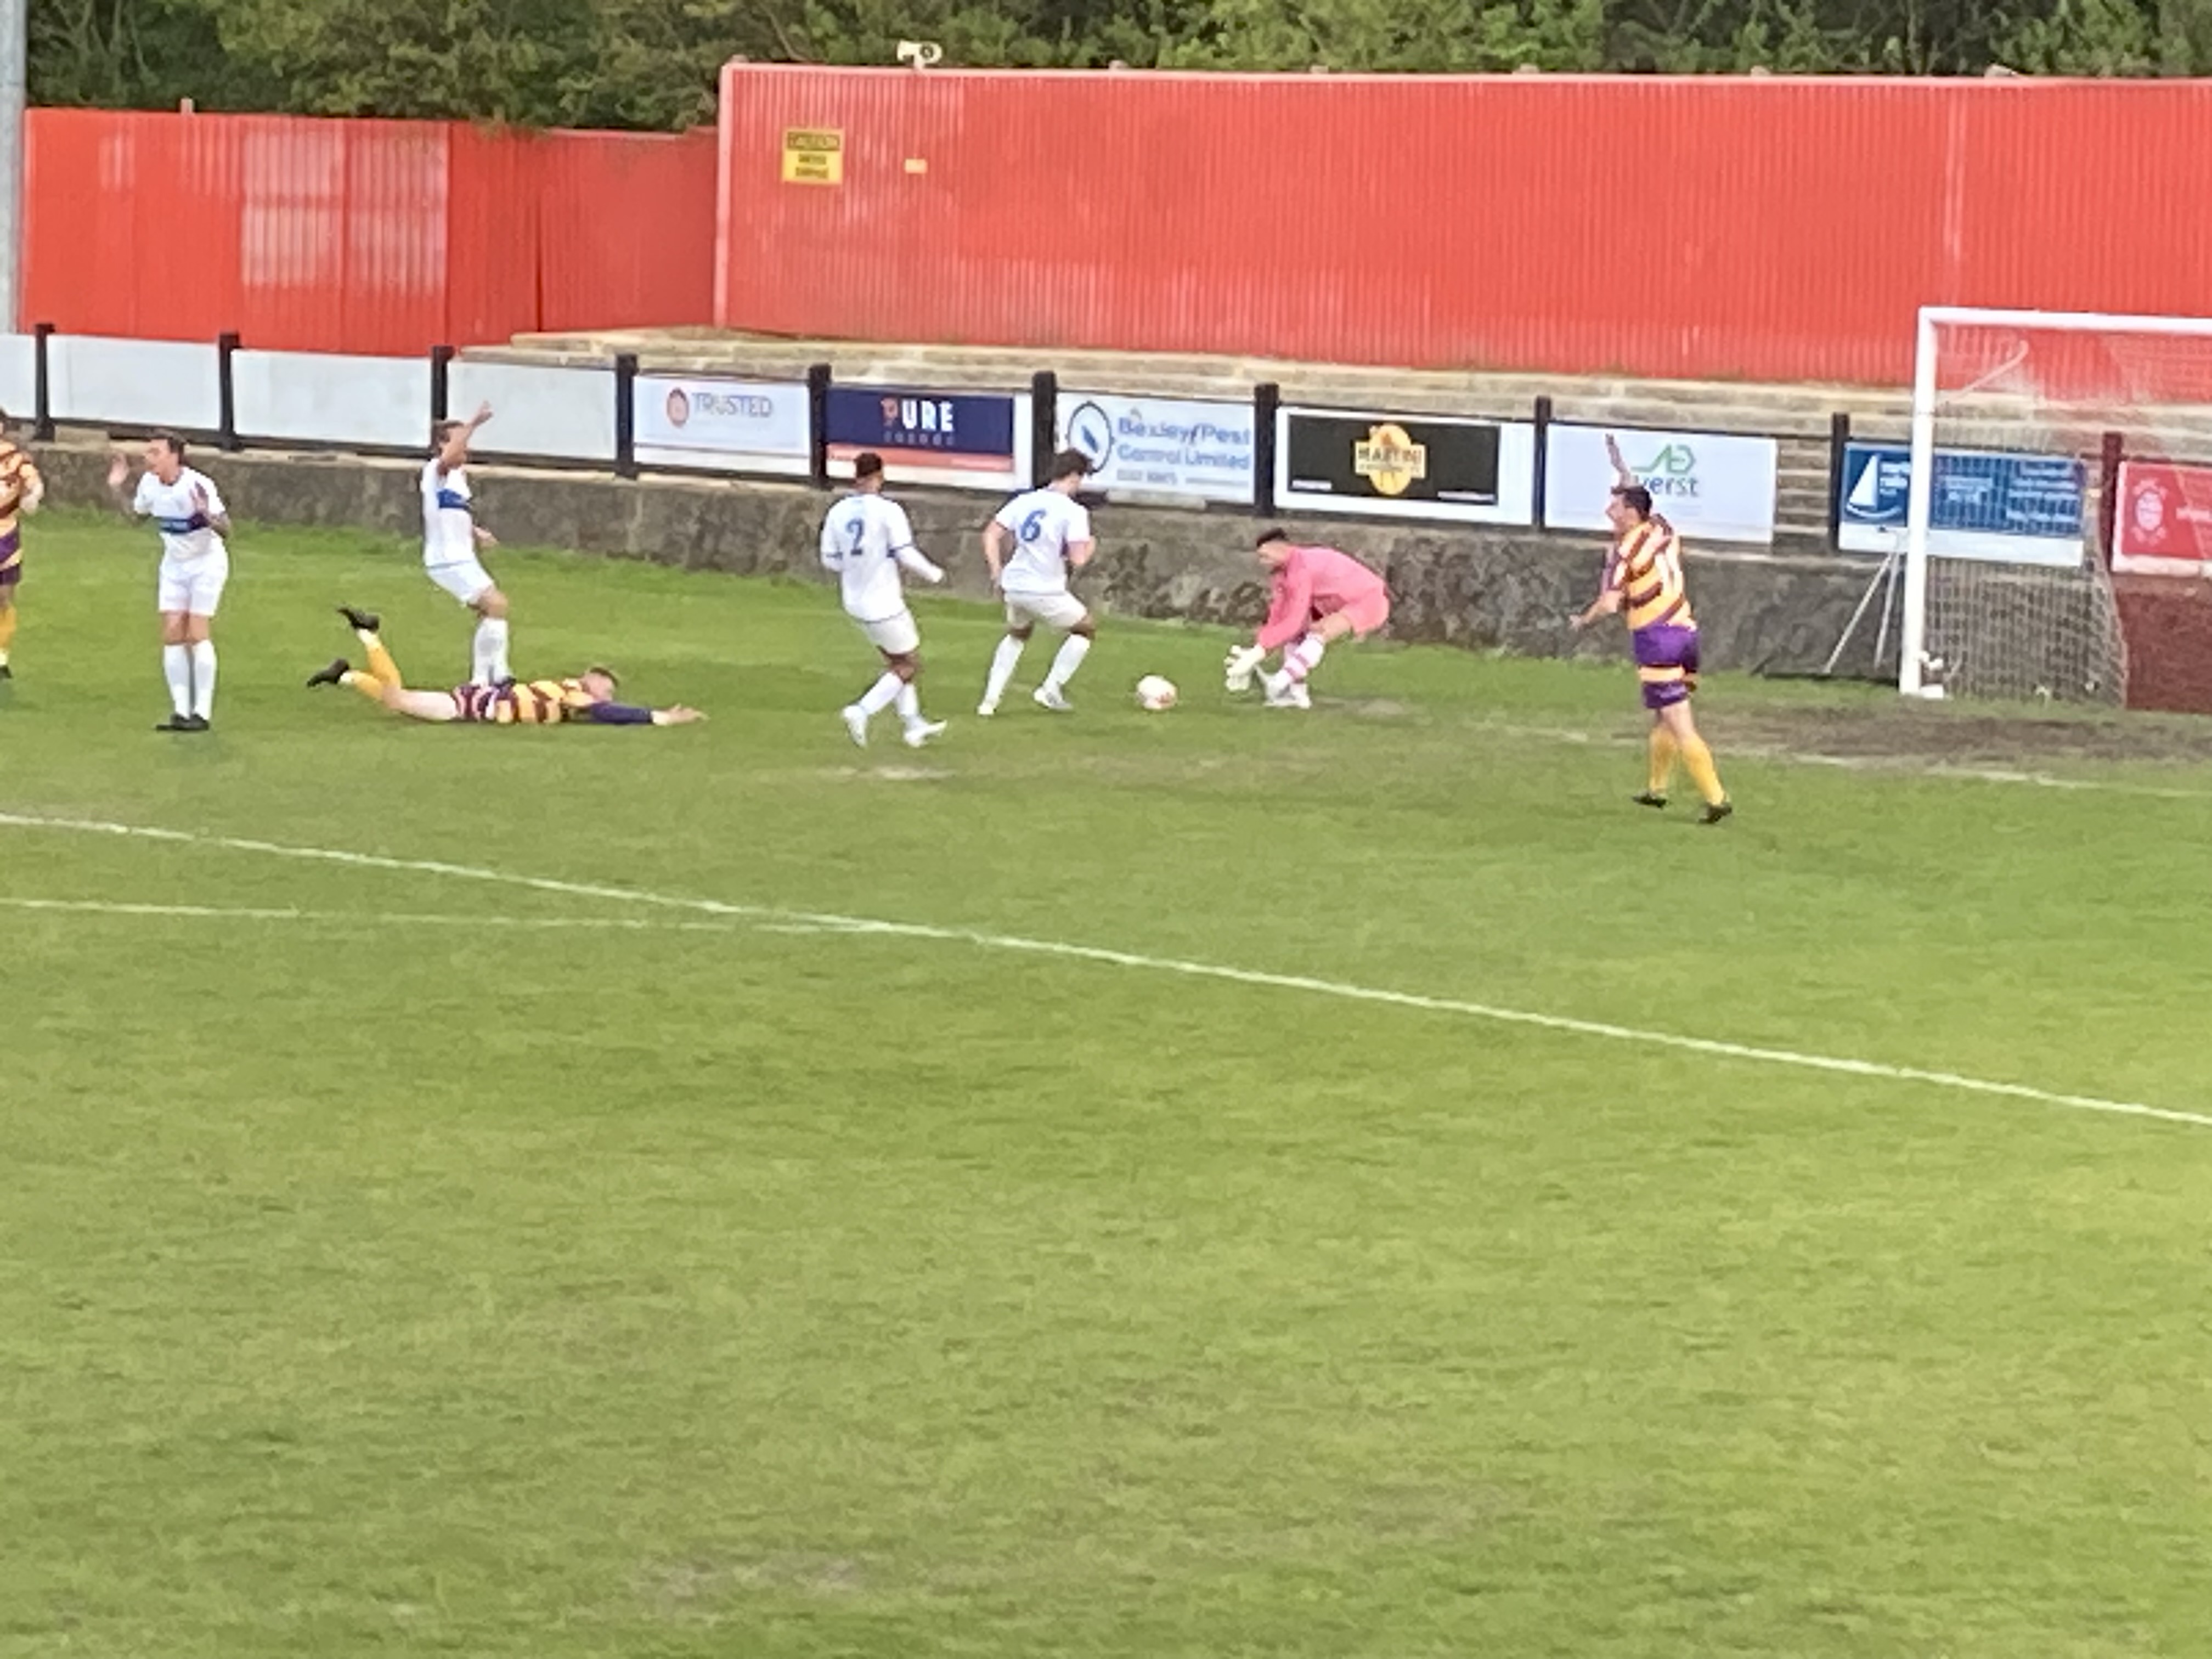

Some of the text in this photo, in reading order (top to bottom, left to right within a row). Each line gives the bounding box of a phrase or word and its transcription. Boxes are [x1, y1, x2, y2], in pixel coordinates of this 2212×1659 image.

[691, 392, 774, 418] TRUSTED
[845, 518, 865, 556] 2
[1020, 510, 1045, 541] 6
